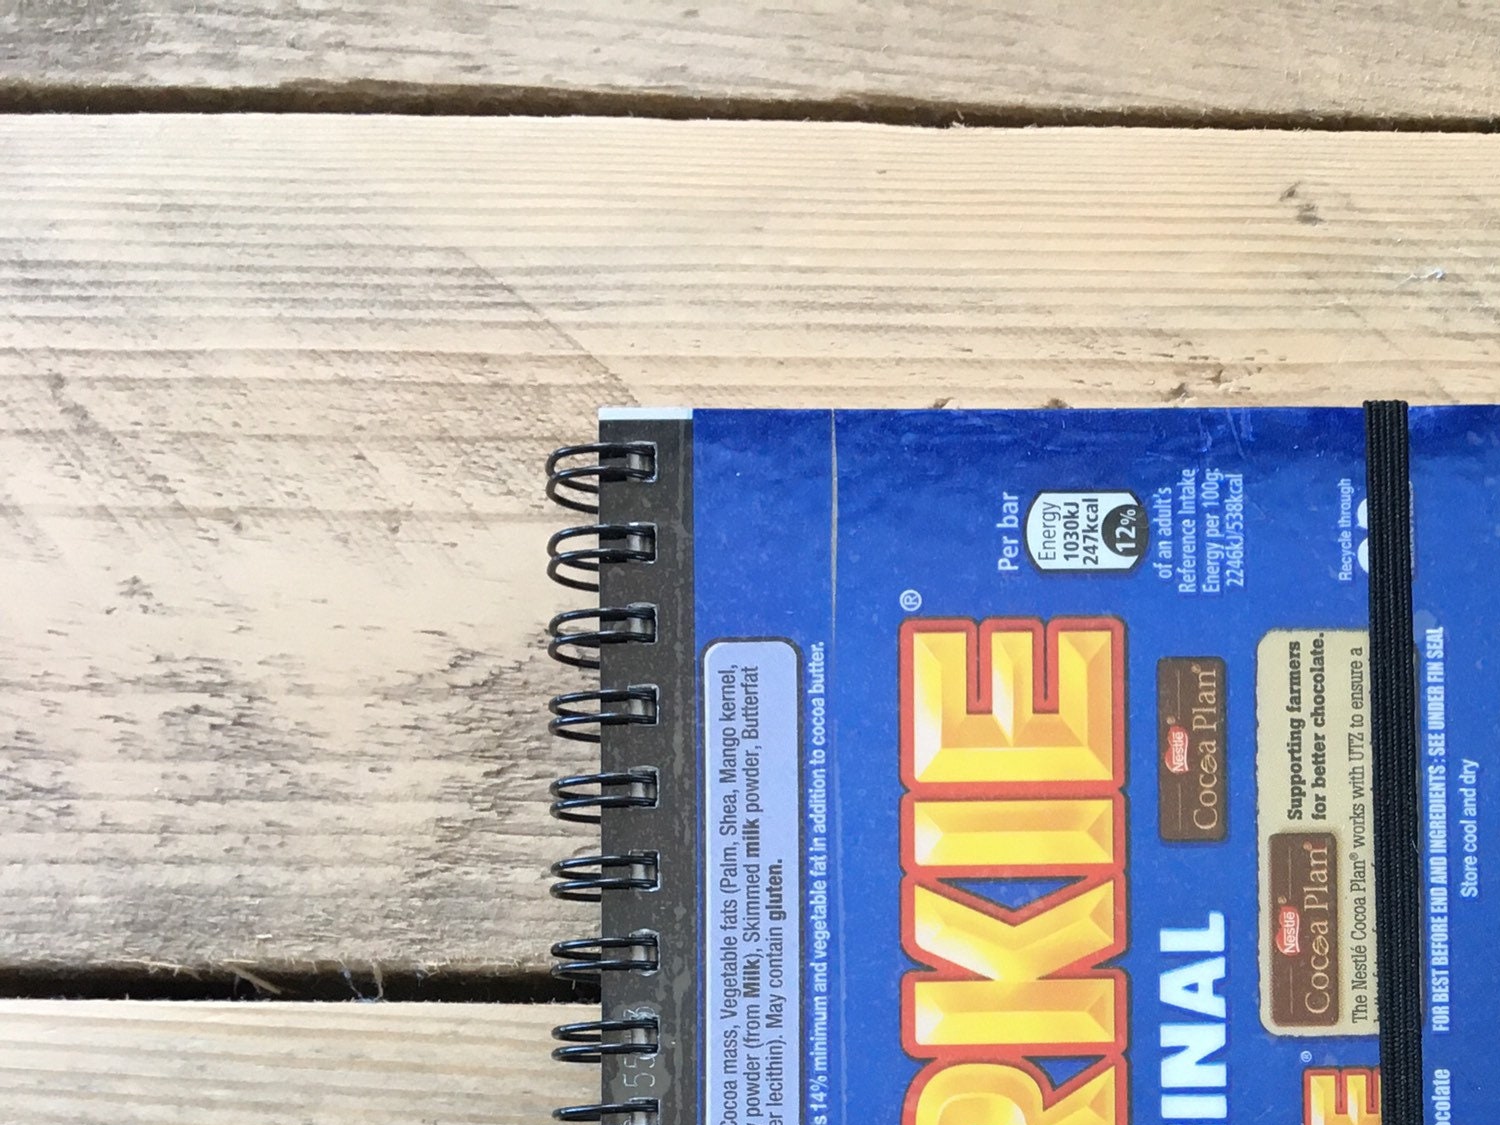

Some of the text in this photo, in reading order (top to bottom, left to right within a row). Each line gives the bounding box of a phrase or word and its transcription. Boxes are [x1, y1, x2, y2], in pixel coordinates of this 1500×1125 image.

[996, 491, 1020, 571] Per bar
[1038, 502, 1061, 560] Energy
[1062, 502, 1079, 561] 1030kJ
[1082, 498, 1098, 565] 247kcal
[1112, 507, 1136, 553] 12%
[1151, 487, 1173, 579] of an adult's
[1175, 465, 1198, 592] Reference Intake
[1200, 465, 1225, 592] Energy per 100g:
[1224, 471, 1246, 587] 2246kJ/538kcal
[1336, 478, 1356, 581] Recycle through
[807, 642, 825, 694] butter.
[1425, 625, 1444, 659] SEAL
[718, 665, 741, 721] kernel,
[1426, 661, 1444, 683] FIN
[810, 697, 826, 746] cocoa
[1286, 641, 1306, 820] Supporting farmers
[1309, 632, 1326, 820] for better chocolate.
[1426, 685, 1445, 730] UNDER
[719, 727, 740, 783] Mango
[808, 749, 826, 767] to
[1427, 733, 1445, 756] SEE
[719, 789, 740, 836] Shea,
[808, 768, 827, 834] addition
[809, 837, 827, 852] in
[1458, 759, 1479, 897] Store cool and dry
[719, 842, 741, 894] (Palm,
[765, 859, 787, 921] gluten.
[809, 855, 827, 877] fat
[1429, 856, 1447, 885] AND
[720, 899, 738, 931] fats
[809, 880, 830, 961] vegetable
[1429, 887, 1448, 913] END
[765, 927, 783, 988] contain
[1430, 915, 1449, 966] BEFORE
[720, 936, 741, 1019] Vegetable
[809, 962, 827, 993] and
[1430, 967, 1449, 1003] BEST
[765, 994, 787, 1028] May
[809, 996, 830, 1073] minimum
[1431, 1006, 1450, 1031] FOR
[723, 1025, 741, 1074] mass,
[765, 1035, 787, 1107] lecithin).
[809, 1075, 829, 1111] 14%
